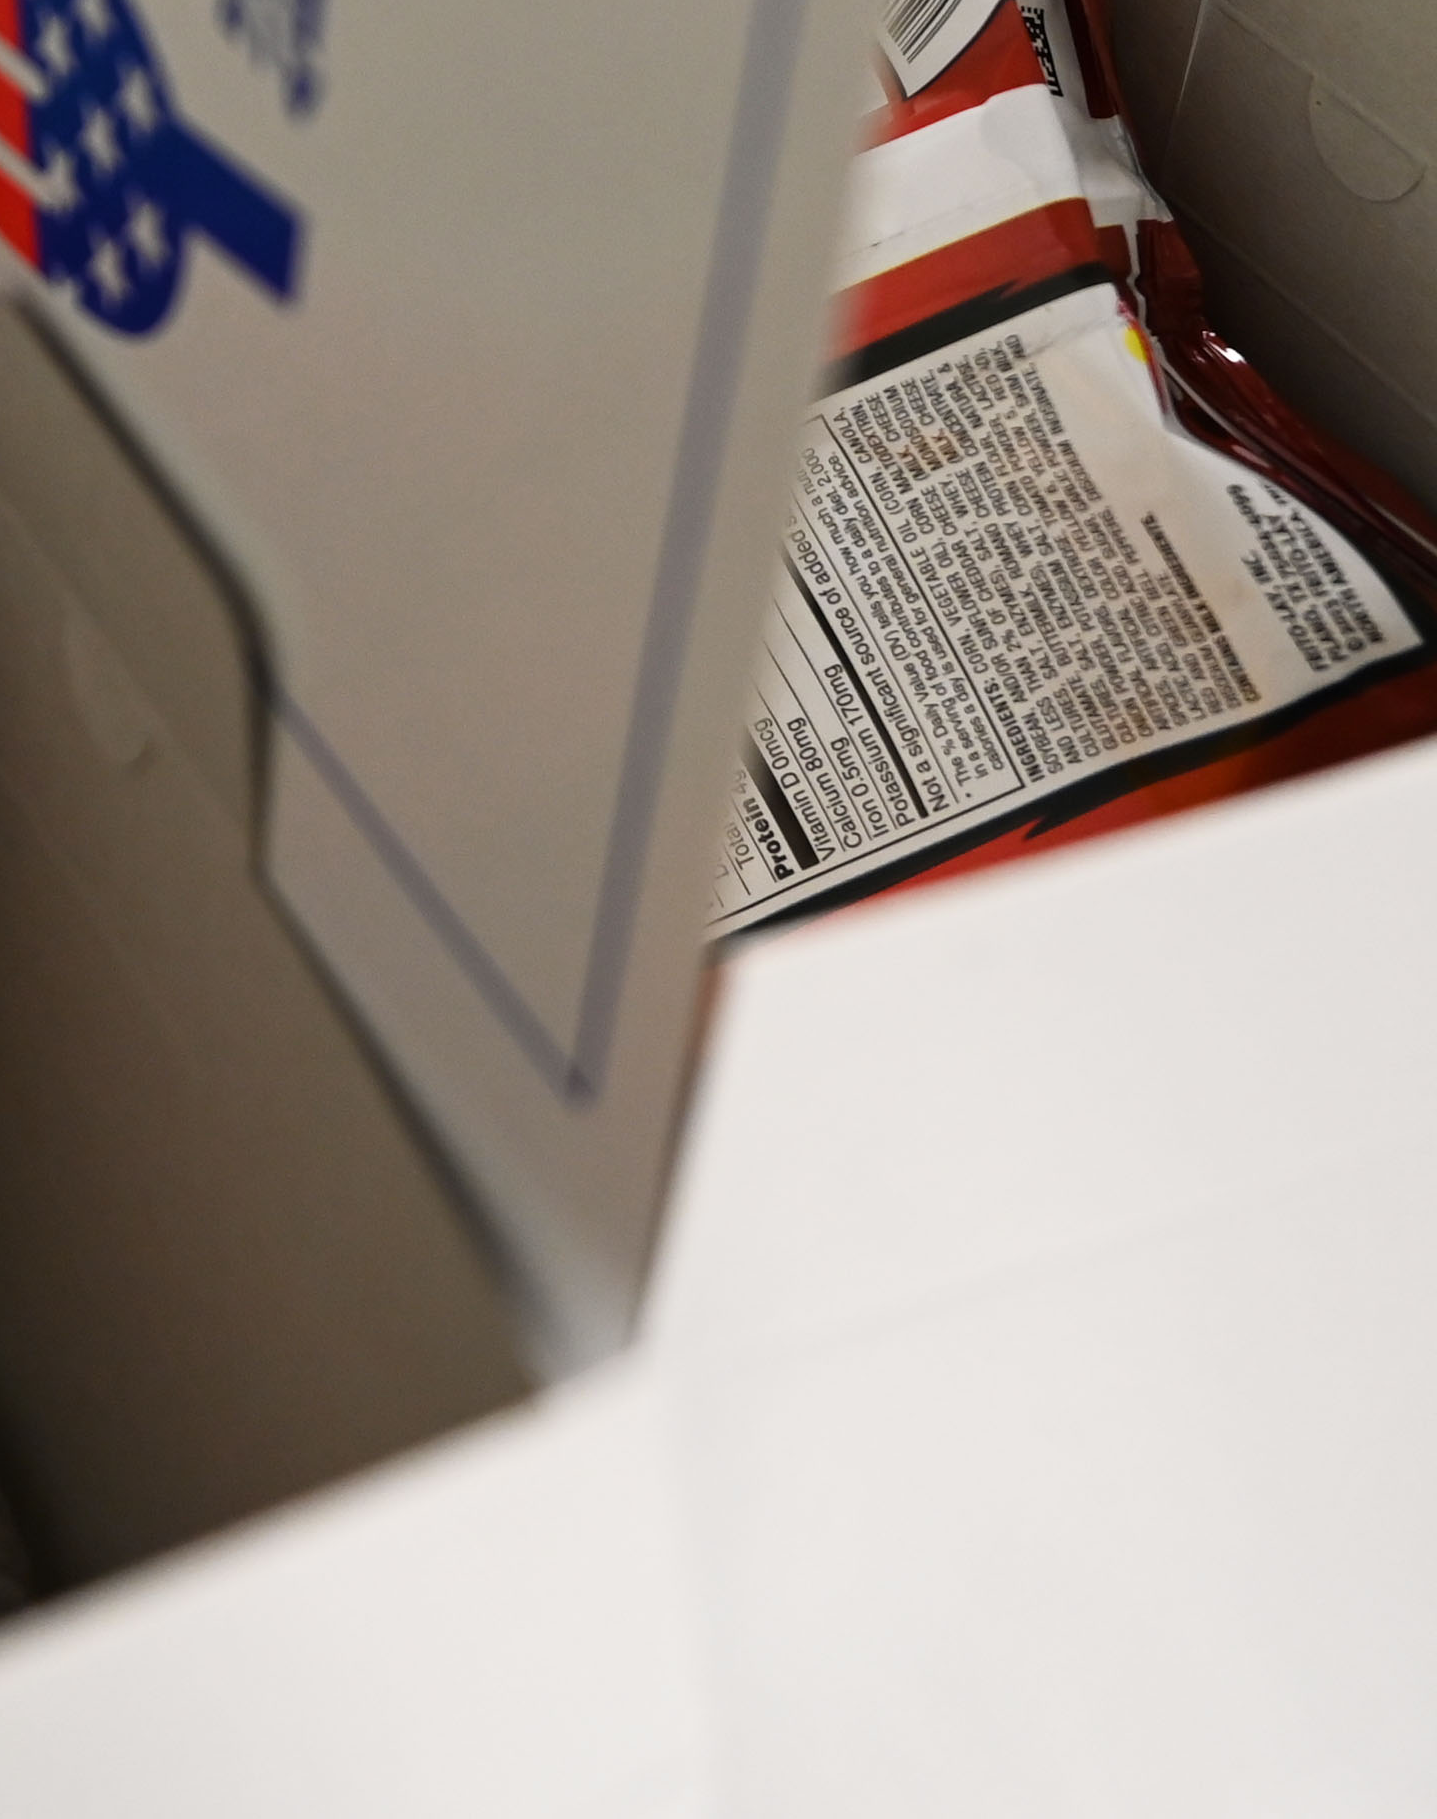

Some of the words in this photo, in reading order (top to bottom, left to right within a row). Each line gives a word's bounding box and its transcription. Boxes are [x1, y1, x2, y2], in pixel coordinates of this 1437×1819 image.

[832, 406, 873, 464] CANOLA,
[864, 392, 901, 443] CHEESE
[849, 397, 913, 496] MALTODEXTRIN,
[827, 451, 860, 499] advice.
[868, 465, 905, 515] (CORN,
[810, 494, 823, 507] a
[824, 485, 849, 516] diet.
[904, 496, 935, 535] CORN
[920, 484, 958, 536] CHEESE
[816, 506, 845, 545] much
[841, 516, 867, 549] daily
[852, 498, 890, 553] nutrition
[896, 517, 918, 544] OIL
[789, 528, 831, 585] added
[838, 545, 862, 576] how
[860, 547, 874, 560] a
[866, 559, 882, 577] to
[930, 536, 954, 569] OIL),
[950, 538, 994, 602] CHEDDAR
[817, 586, 842, 605] of
[854, 573, 880, 601] you
[880, 552, 921, 604] general
[909, 545, 962, 627] VEGETABLE
[869, 599, 892, 630] tells
[875, 574, 922, 649] contributes
[909, 606, 929, 626] for
[945, 570, 999, 650] SUNFLOWER
[984, 607, 1007, 626] OF
[833, 606, 876, 666] source
[882, 628, 913, 661] (DV)
[919, 624, 948, 660] used
[956, 627, 989, 674] CORN,
[1000, 627, 1023, 653] 2%
[902, 661, 930, 703] Value
[911, 648, 939, 682] food
[940, 660, 956, 676] is
[990, 652, 1029, 703] AND/OR
[1013, 655, 1043, 694] THAN
[822, 662, 864, 727] 170mg
[928, 681, 948, 697] of
[948, 676, 970, 703] day
[962, 702, 977, 715] a
[864, 666, 923, 757] significant
[922, 702, 949, 739] Daily
[937, 695, 975, 750] serving
[983, 676, 1045, 783] INGREDIENTS:
[1035, 695, 1065, 732] LESS
[753, 716, 790, 770] 0mcg
[785, 716, 824, 772] 80mg
[940, 737, 957, 757] %
[967, 749, 981, 762] a
[968, 714, 1005, 771] calories
[1021, 706, 1064, 774] SOYBEAN,
[1055, 734, 1084, 764] AND
[779, 770, 801, 790] D
[829, 735, 870, 798] 0.5mg
[850, 727, 916, 827] Potassium
[914, 758, 932, 774] a
[950, 755, 972, 787] The
[973, 762, 989, 779] in
[810, 771, 863, 849] Calcium
[920, 775, 951, 813] Not
[792, 788, 836, 862] Vitamin
[855, 797, 890, 839] Iron
[742, 796, 795, 881] Protein
